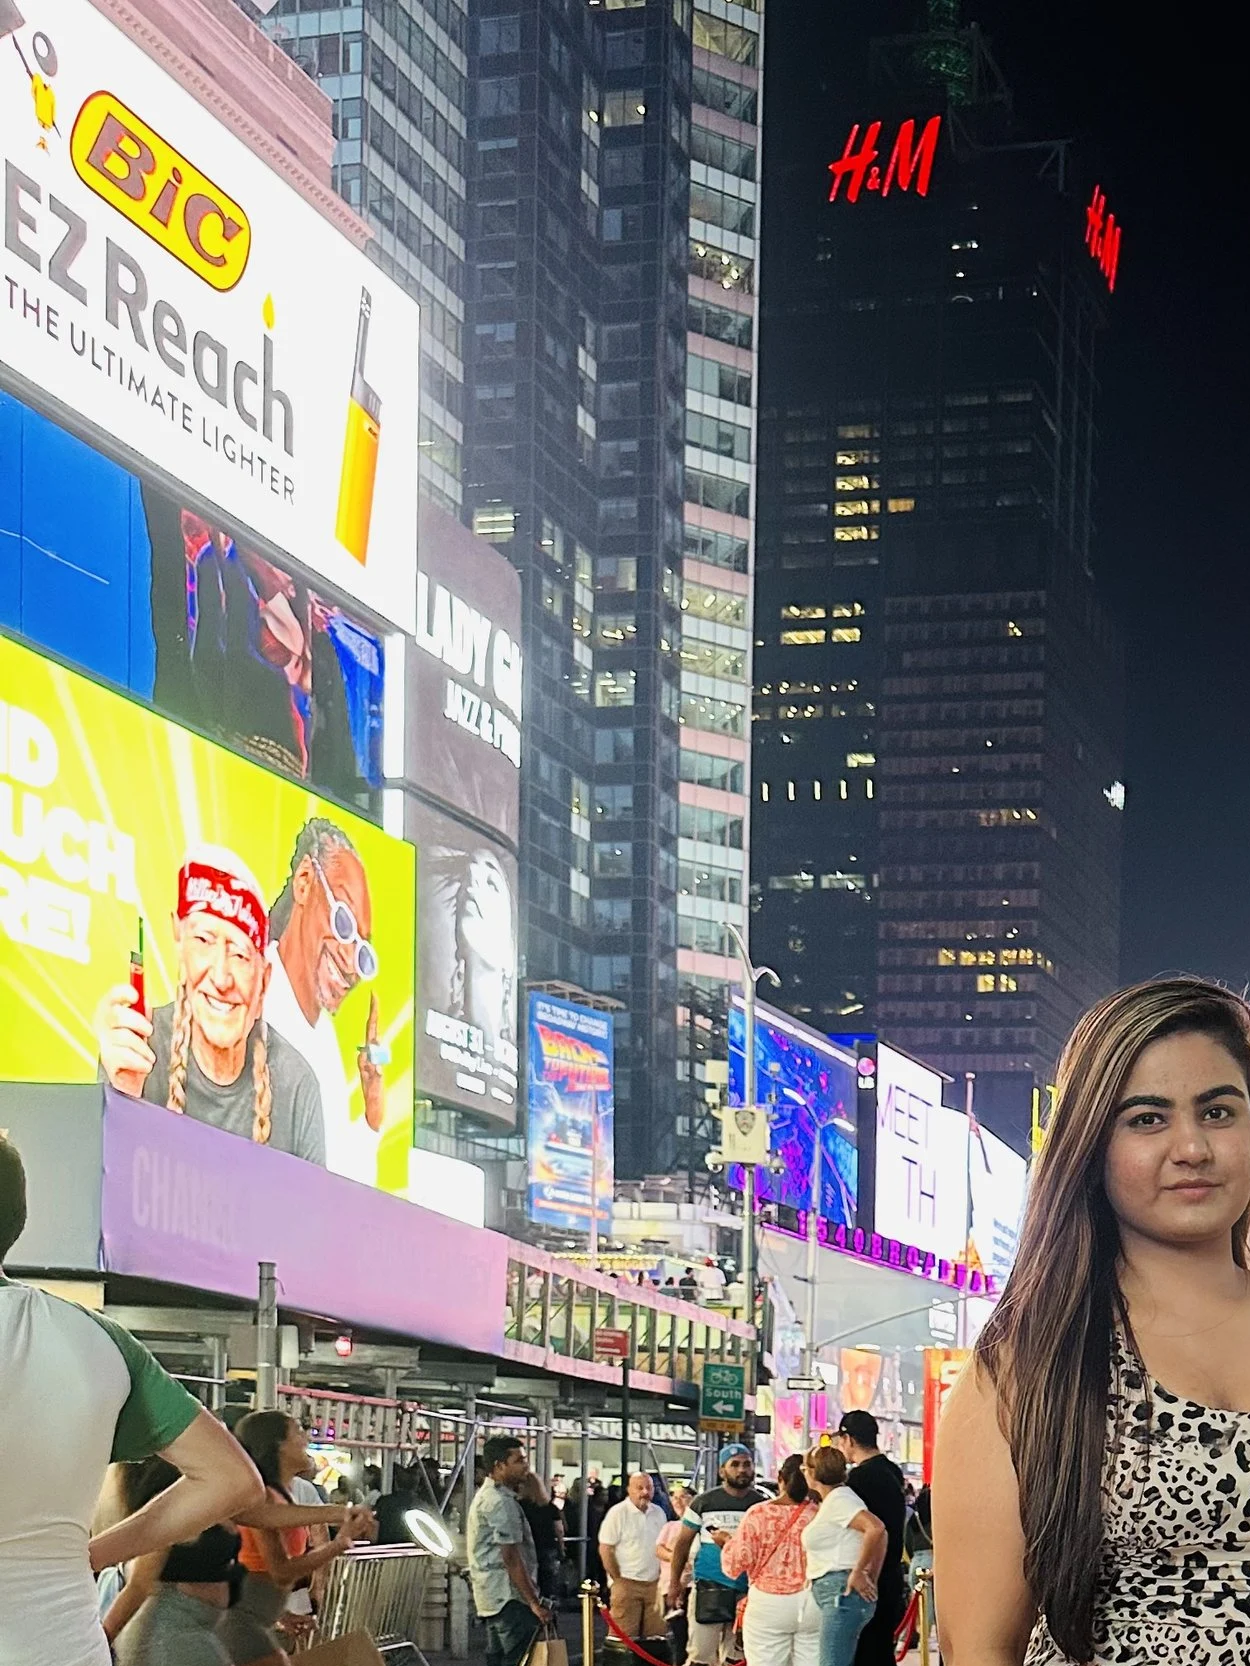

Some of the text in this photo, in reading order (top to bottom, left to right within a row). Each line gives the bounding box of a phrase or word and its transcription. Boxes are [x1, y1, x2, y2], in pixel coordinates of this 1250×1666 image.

[828, 115, 941, 203] H&M
[5, 158, 294, 458] EZ Reach
[5, 274, 295, 505] THE ULTIMATE LIGHTER
[415, 570, 492, 688] LADY
[704, 1388, 743, 1400] South
